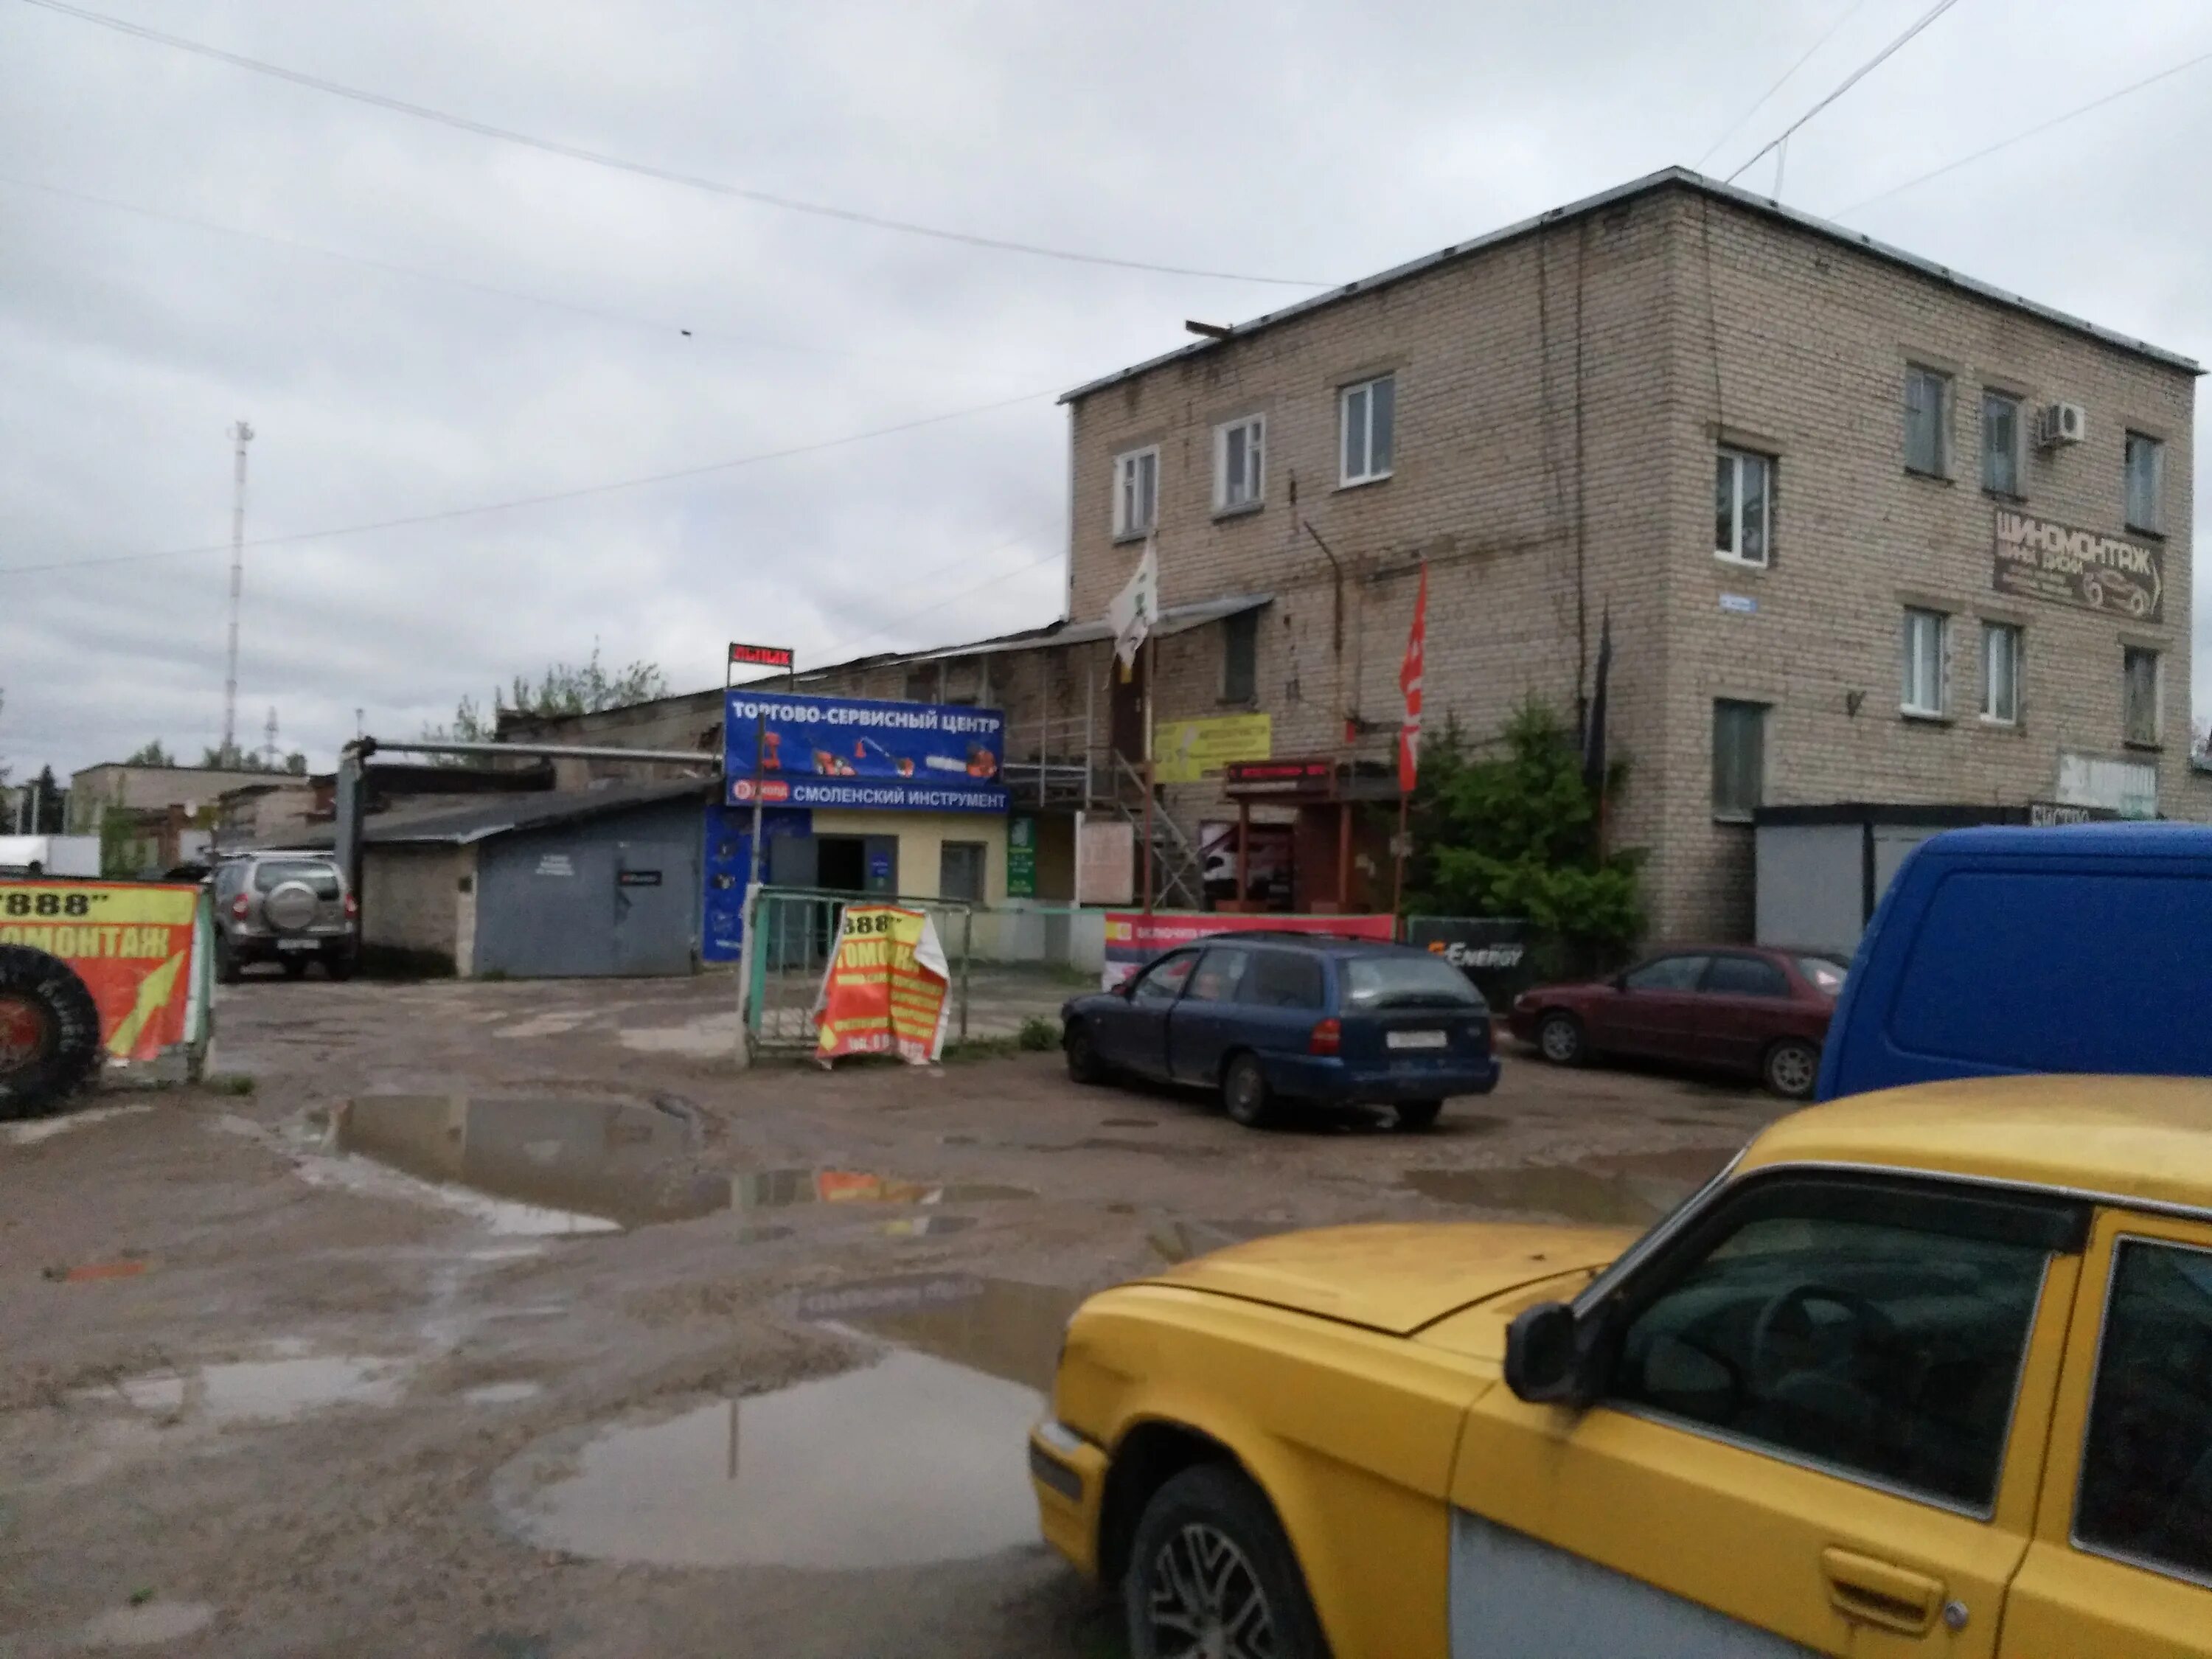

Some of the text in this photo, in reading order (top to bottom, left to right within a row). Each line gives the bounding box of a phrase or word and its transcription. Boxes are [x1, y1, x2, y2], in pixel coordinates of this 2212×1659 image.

[1997, 512, 2151, 575] ШИНОМОНТАЖ
[733, 700, 1000, 734] ТОРГОВО-СЕРВИСНЫЙ ЦЕНТР
[793, 785, 905, 804] СМОЛЕНСКИЙ
[908, 790, 1006, 808] ИНСТРУМЕНТ
